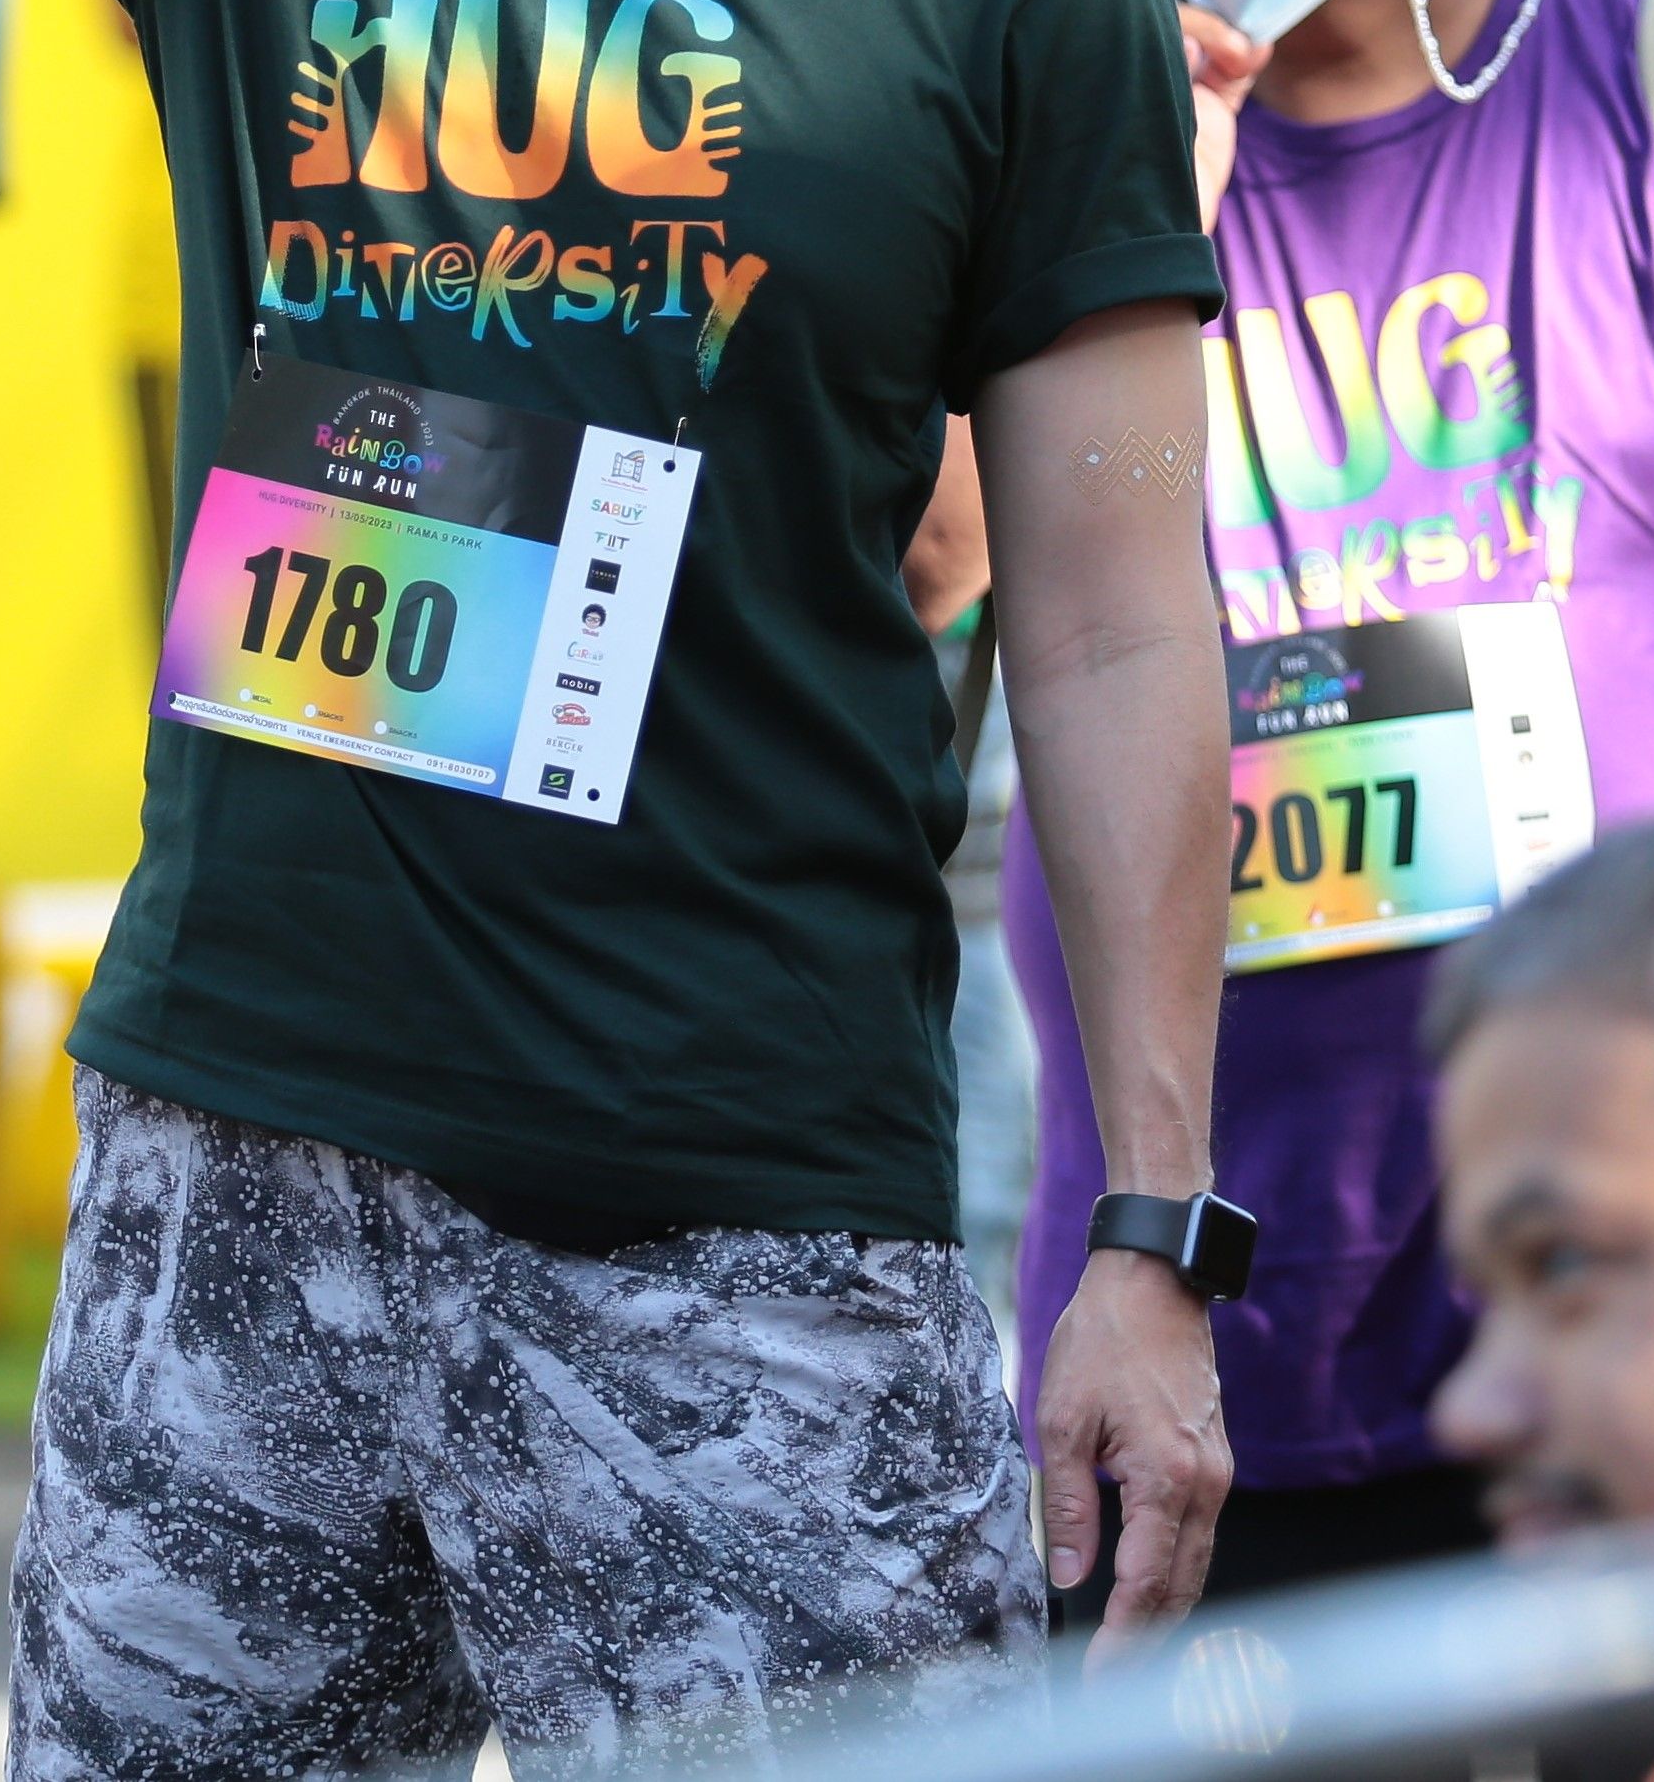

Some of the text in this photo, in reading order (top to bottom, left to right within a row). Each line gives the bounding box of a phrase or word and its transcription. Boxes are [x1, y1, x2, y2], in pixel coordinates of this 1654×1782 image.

[377, 385, 421, 417] THAILAND
[369, 408, 397, 429] THE
[373, 474, 417, 499] RUN
[279, 495, 327, 515] DIVERSITY
[340, 509, 393, 531] 13/05/2023
[406, 524, 439, 541] RAMA
[451, 535, 483, 551] PARK
[591, 498, 643, 521] SABUY
[240, 545, 458, 694] 1780
[561, 678, 596, 693] noble
[296, 727, 323, 743] VENUE
[324, 735, 374, 752] EMERGENCY
[374, 746, 415, 763] CONTACT
[1230, 777, 1416, 894] 2077
